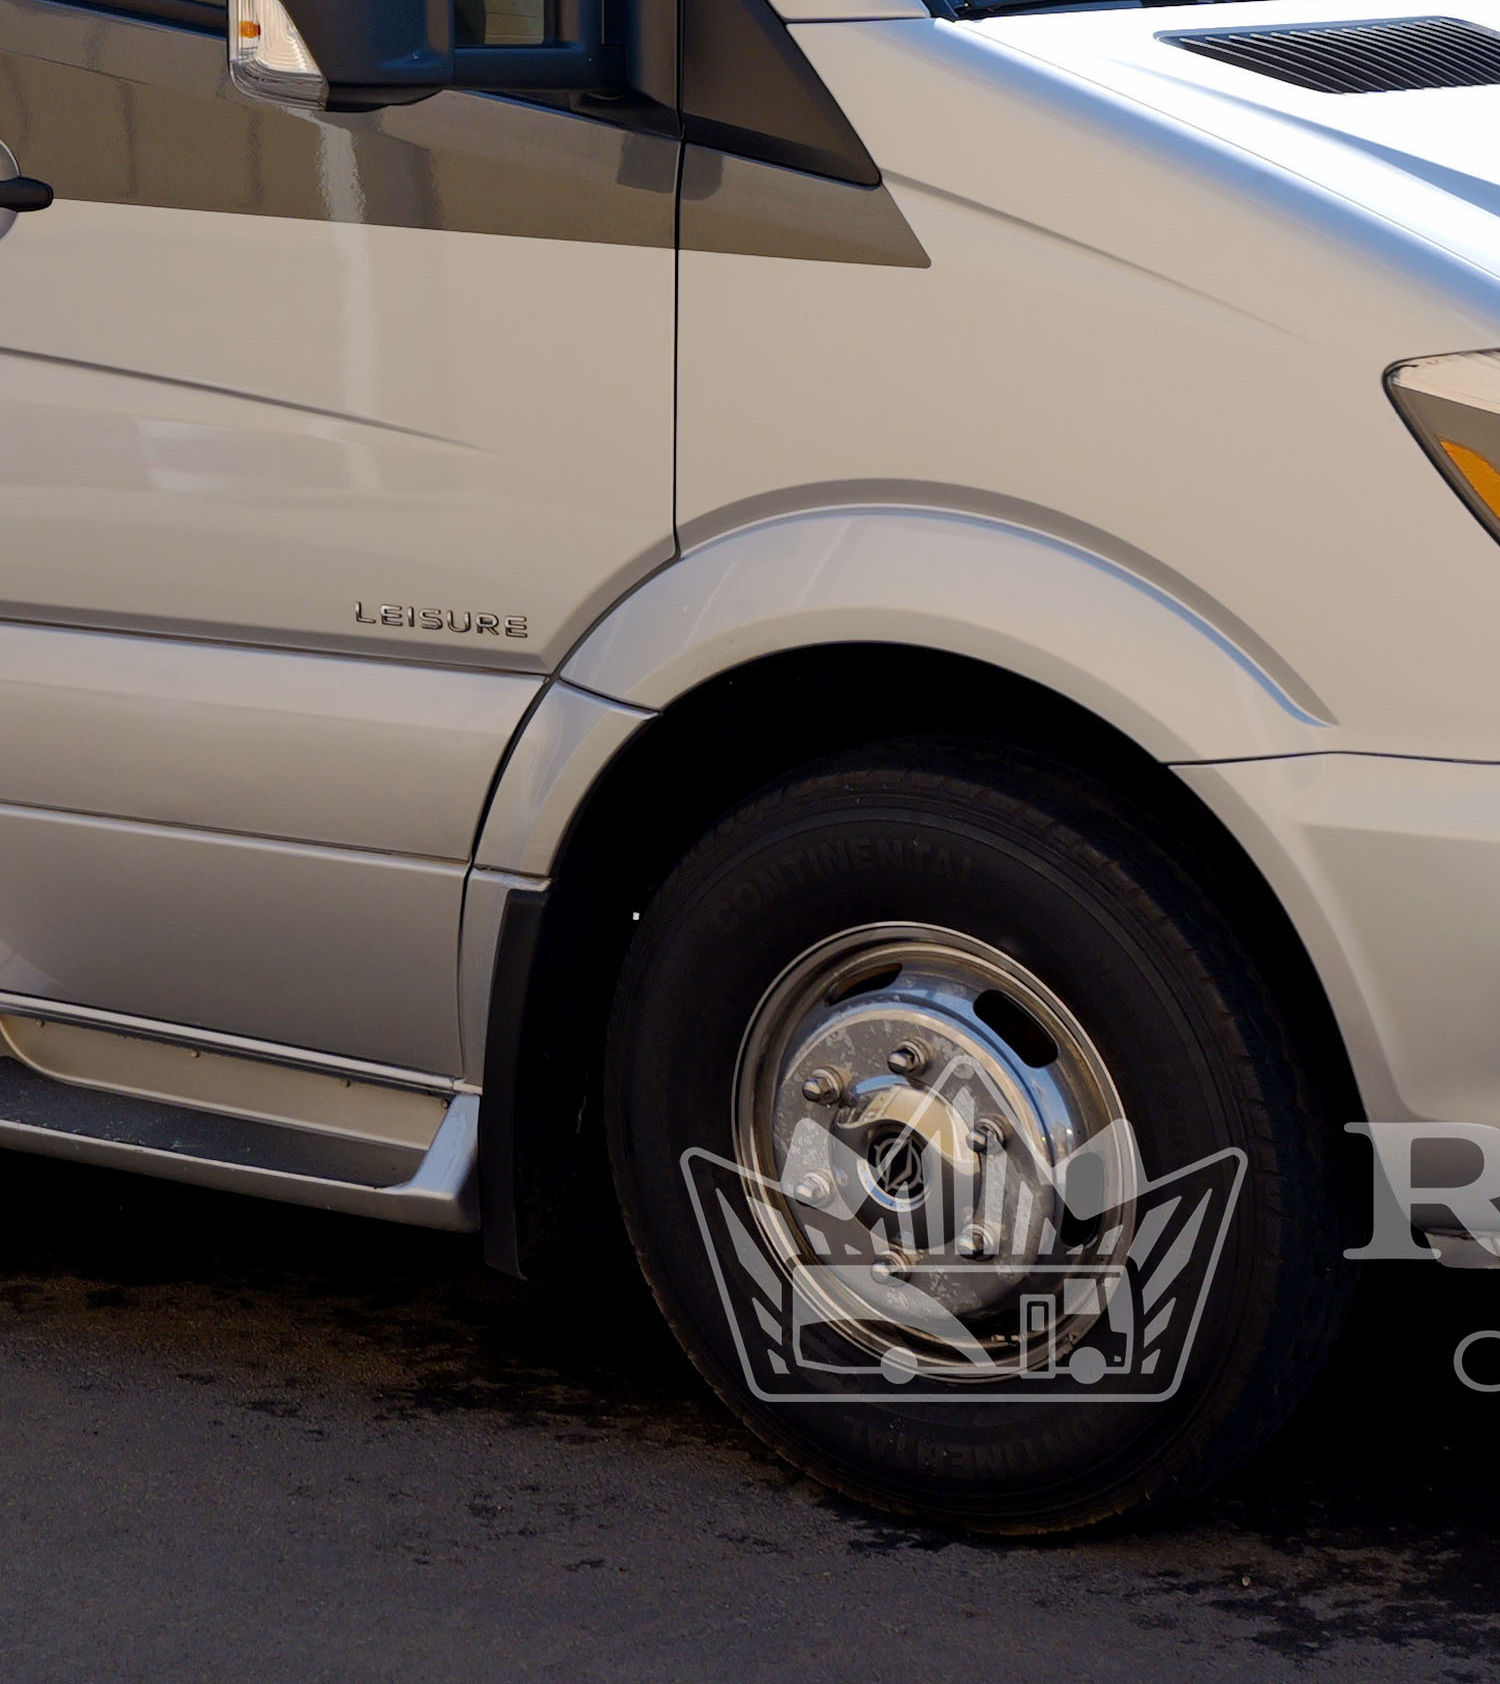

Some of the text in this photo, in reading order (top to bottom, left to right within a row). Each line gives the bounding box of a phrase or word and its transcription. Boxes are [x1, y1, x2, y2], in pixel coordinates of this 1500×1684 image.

[354, 601, 529, 639] LEISURE
[713, 835, 975, 934] CONTINENTAL
[843, 1412, 1104, 1480] ONTINENTAL
